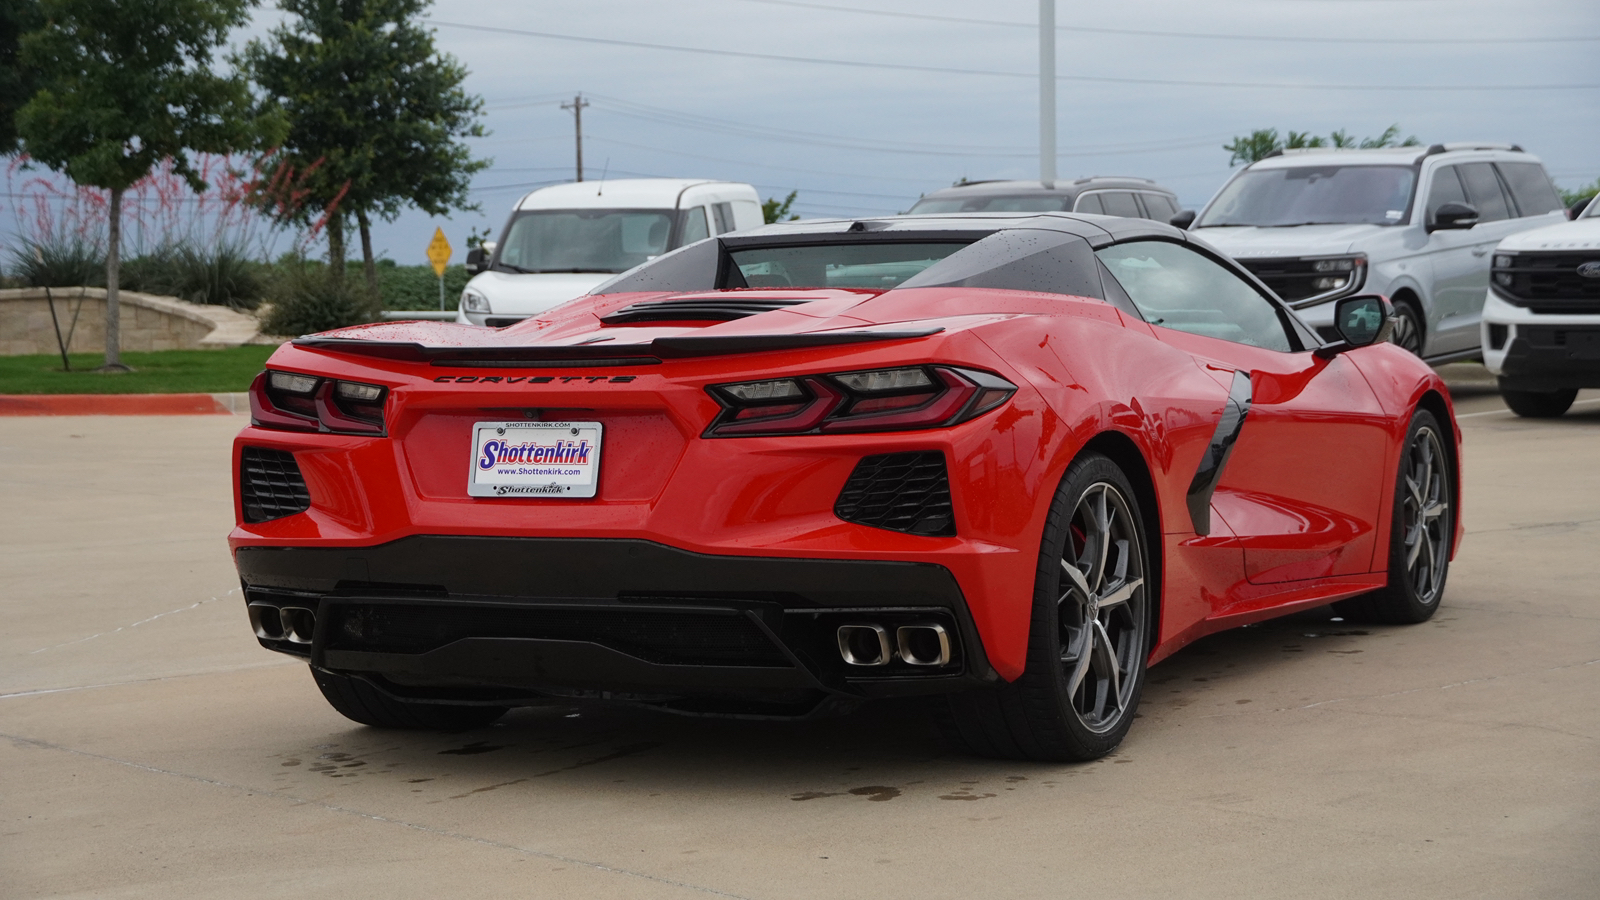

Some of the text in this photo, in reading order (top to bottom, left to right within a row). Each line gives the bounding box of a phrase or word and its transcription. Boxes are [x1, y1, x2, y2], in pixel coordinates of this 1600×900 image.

[433, 376, 636, 384] CORVETTE
[479, 439, 592, 470] Shottenkirk
[497, 467, 581, 476] www.Shottenkirk.com
[496, 484, 564, 495] Shottenkirk
